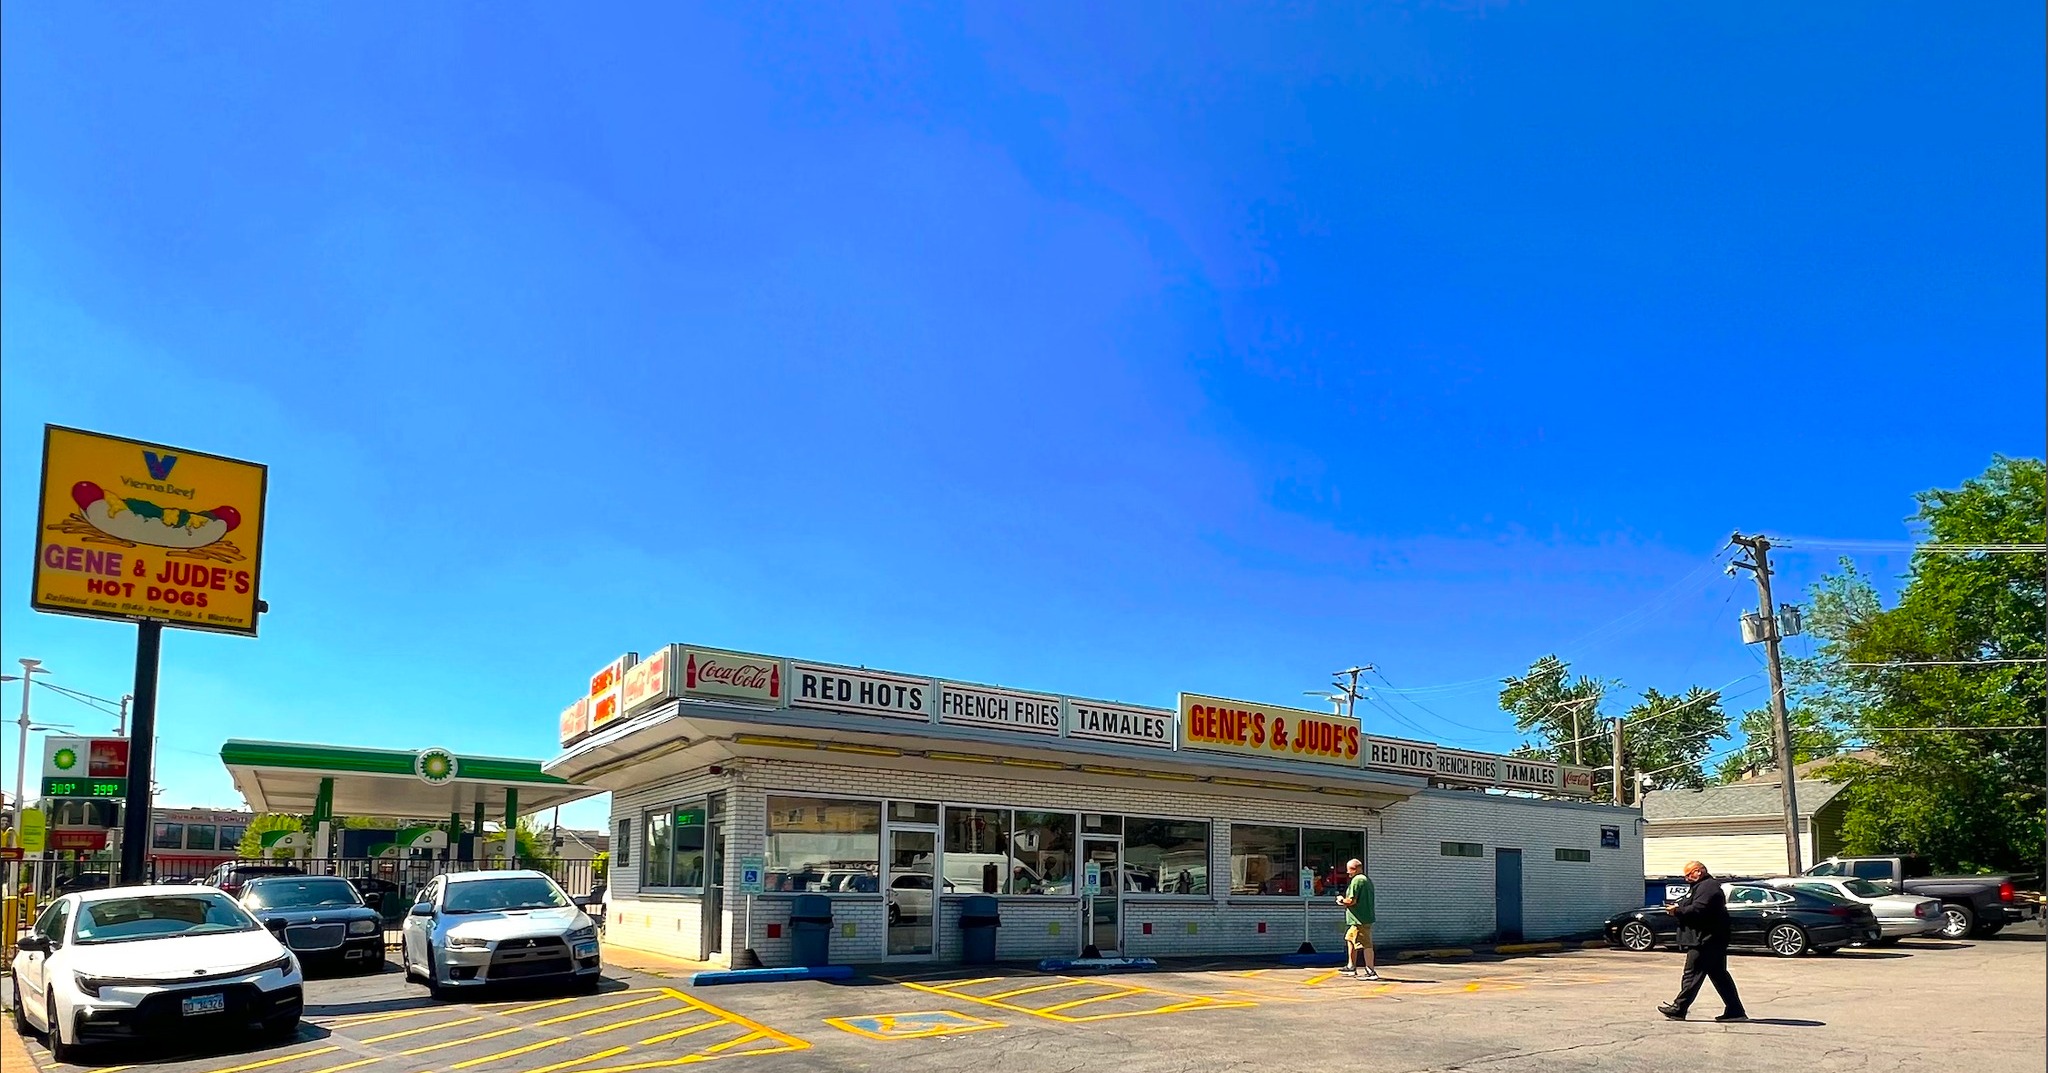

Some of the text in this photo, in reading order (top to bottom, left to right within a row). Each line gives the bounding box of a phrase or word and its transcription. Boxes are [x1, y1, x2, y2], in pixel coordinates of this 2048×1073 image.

[120, 475, 195, 499] Vienna Beef
[44, 543, 249, 594] GENE & JUDE'S
[87, 579, 208, 608] HOT DOGS
[698, 659, 771, 689] Coca-Cola
[802, 674, 923, 711] RED HOTS
[942, 691, 1059, 727] FRENCH FRIES
[1078, 708, 1165, 739] TAMALES
[1189, 704, 1359, 760] GENE'S & JUDE'S
[1371, 744, 1433, 768] RED HOTS
[1471, 761, 1496, 778] FRIES
[1505, 763, 1555, 785] TAMALES
